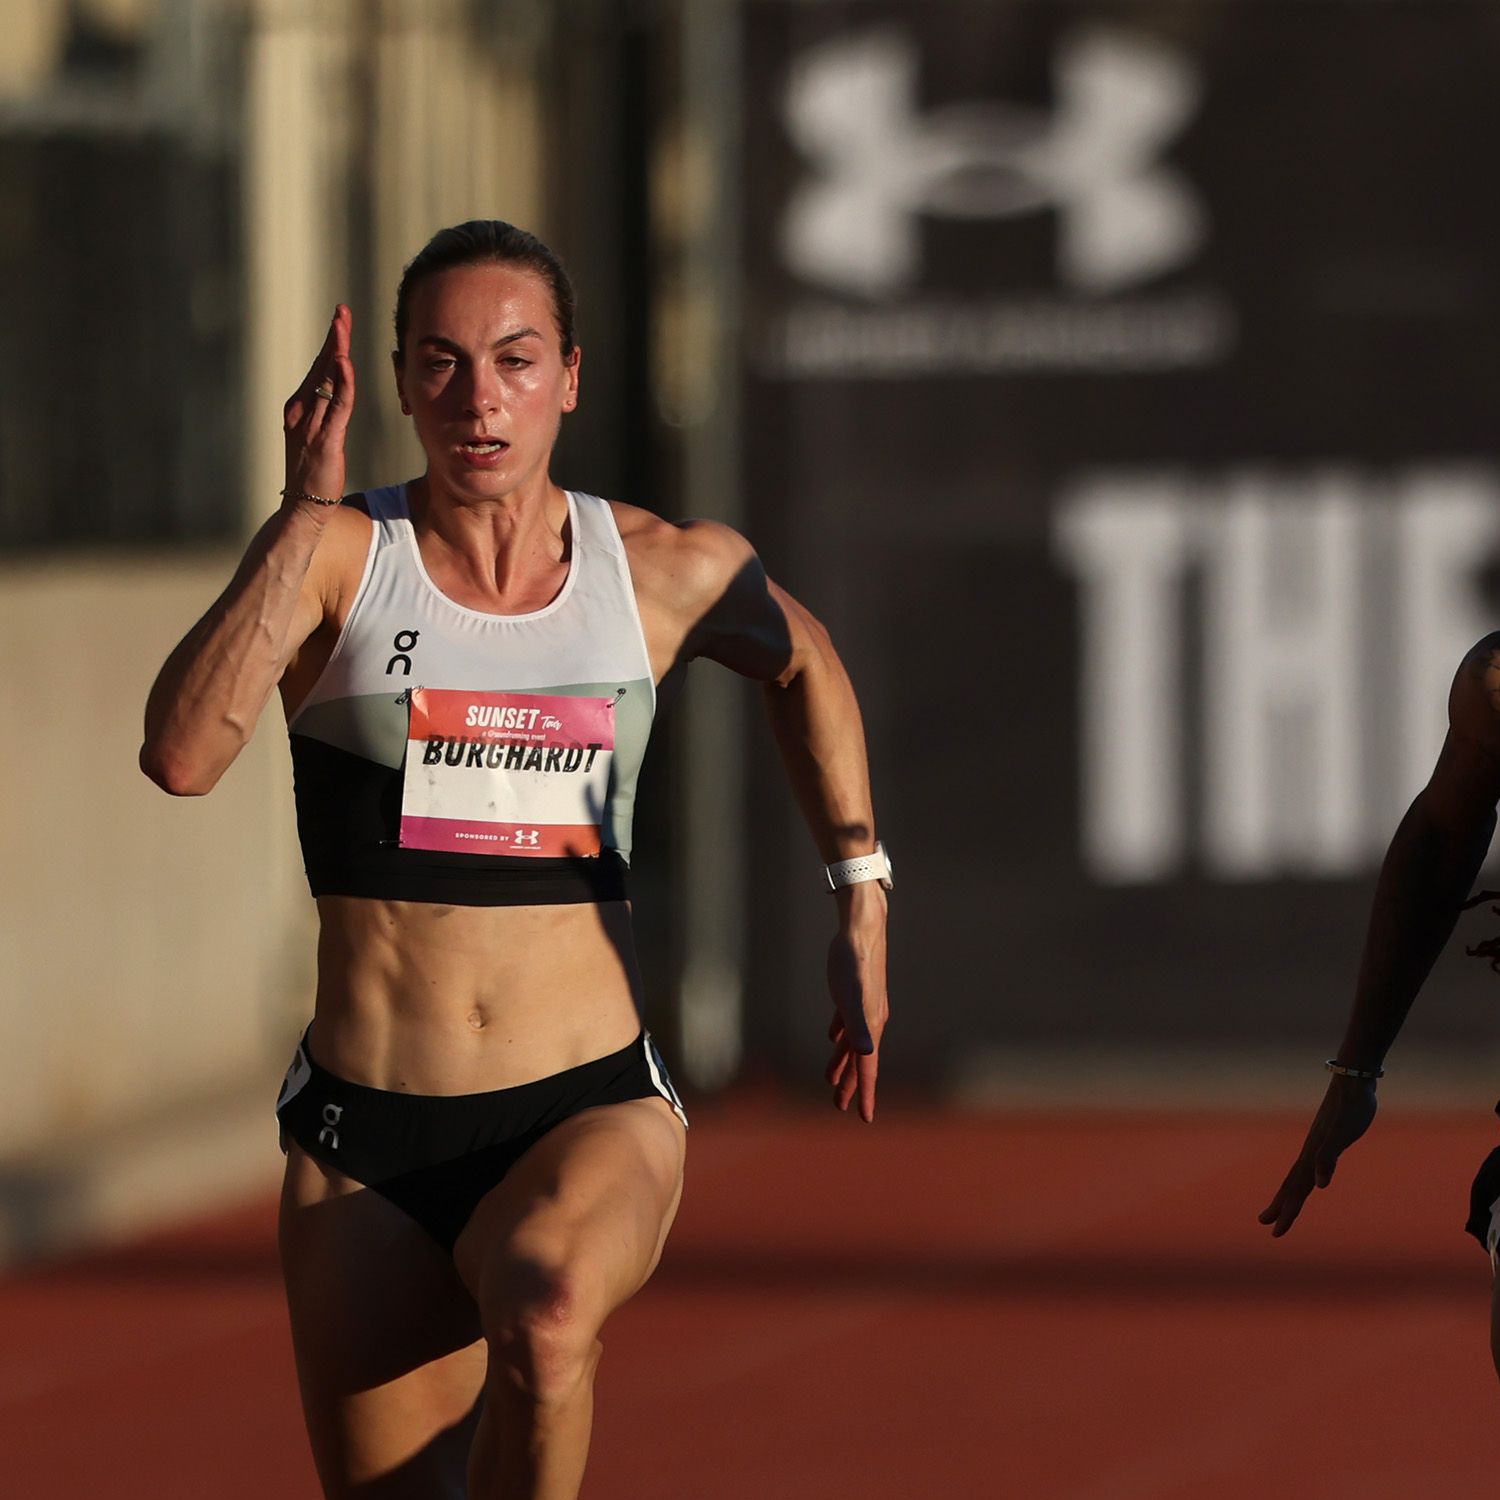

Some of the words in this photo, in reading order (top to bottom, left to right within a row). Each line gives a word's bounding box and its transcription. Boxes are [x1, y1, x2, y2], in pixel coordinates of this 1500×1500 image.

[465, 705, 540, 730] SUNSET
[423, 734, 603, 773] BURGHARDT
[455, 832, 498, 841] SPONSORED
